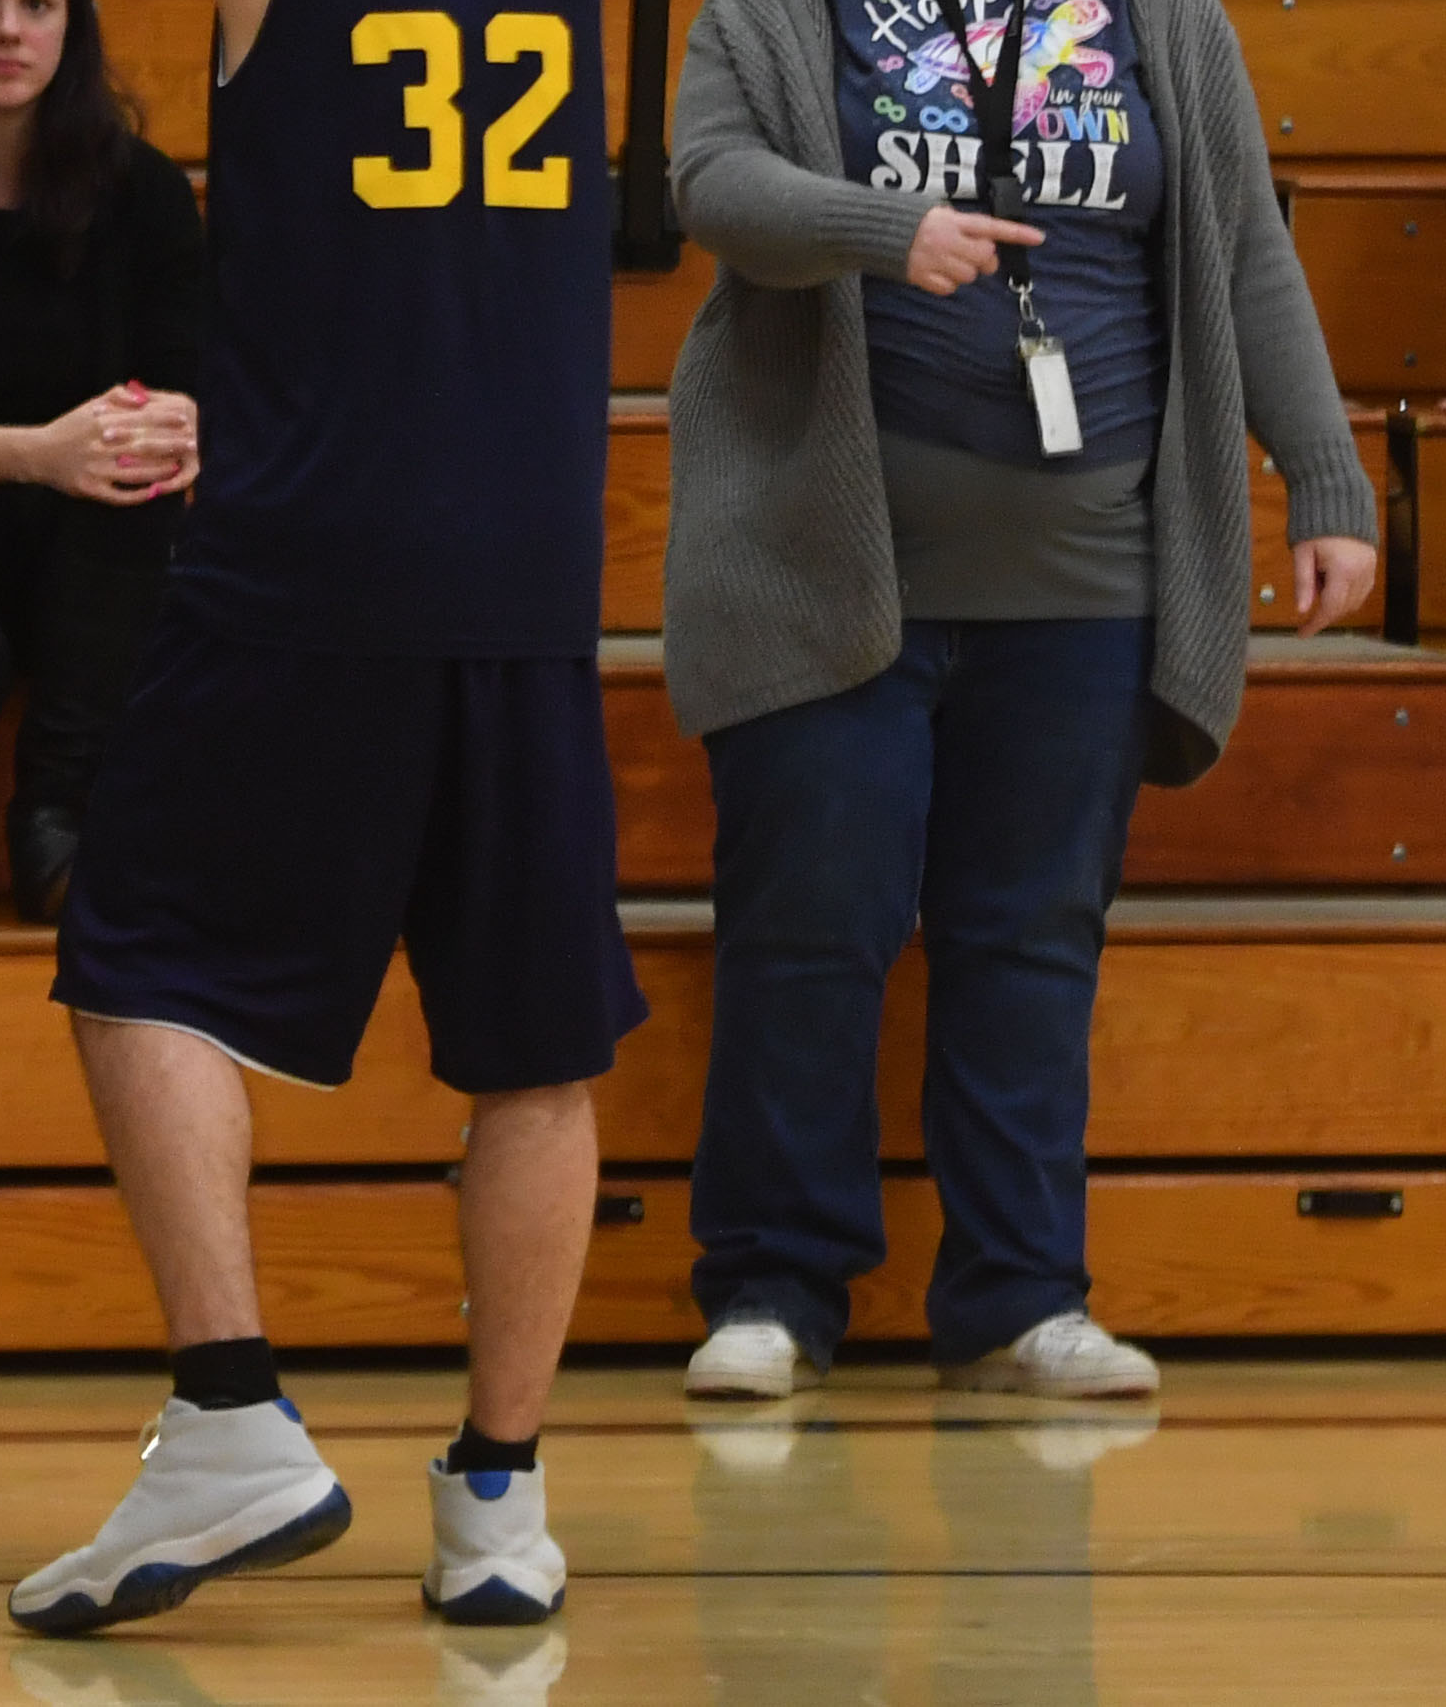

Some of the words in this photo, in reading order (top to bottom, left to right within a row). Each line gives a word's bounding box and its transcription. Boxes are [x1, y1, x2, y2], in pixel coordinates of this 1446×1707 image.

[351, 11, 572, 210] 32
[1049, 88, 1075, 105] in
[1080, 87, 1123, 118] your
[1036, 105, 1130, 145] OWN
